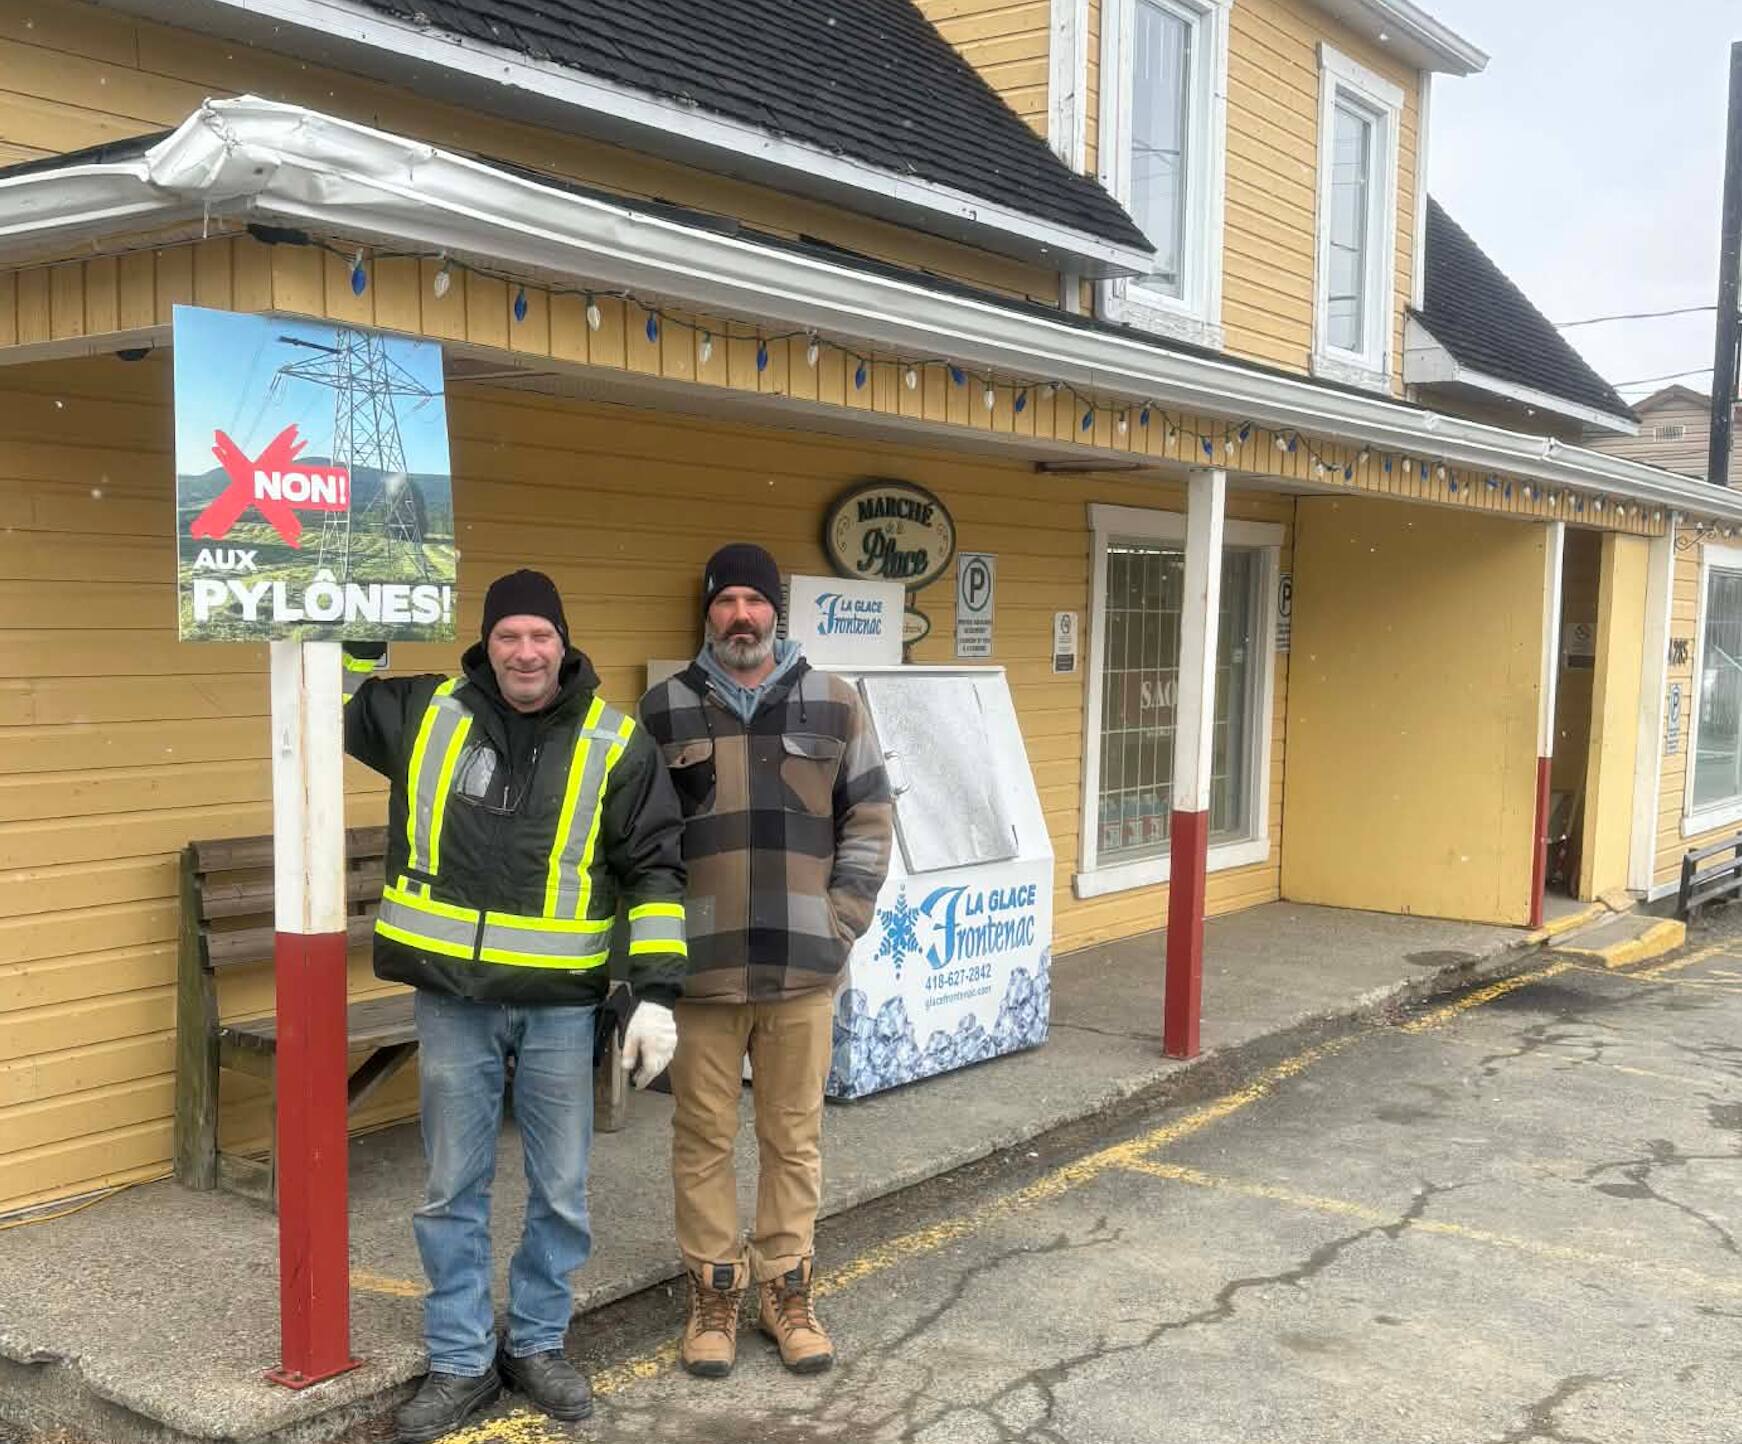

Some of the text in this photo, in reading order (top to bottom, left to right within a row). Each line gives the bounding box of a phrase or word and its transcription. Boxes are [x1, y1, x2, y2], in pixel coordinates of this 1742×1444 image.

[253, 469, 348, 505] NON!
[857, 494, 934, 528] MARCHÉ
[193, 548, 258, 571] AUX
[856, 528, 929, 579] Place
[192, 568, 453, 625] PYLÔNES!
[815, 592, 882, 636] Frontenac
[840, 599, 883, 613] LA GLACE
[965, 884, 1037, 916] LA GLACE
[920, 884, 1036, 971] Frontenac
[925, 962, 993, 991] 418-627-2842
